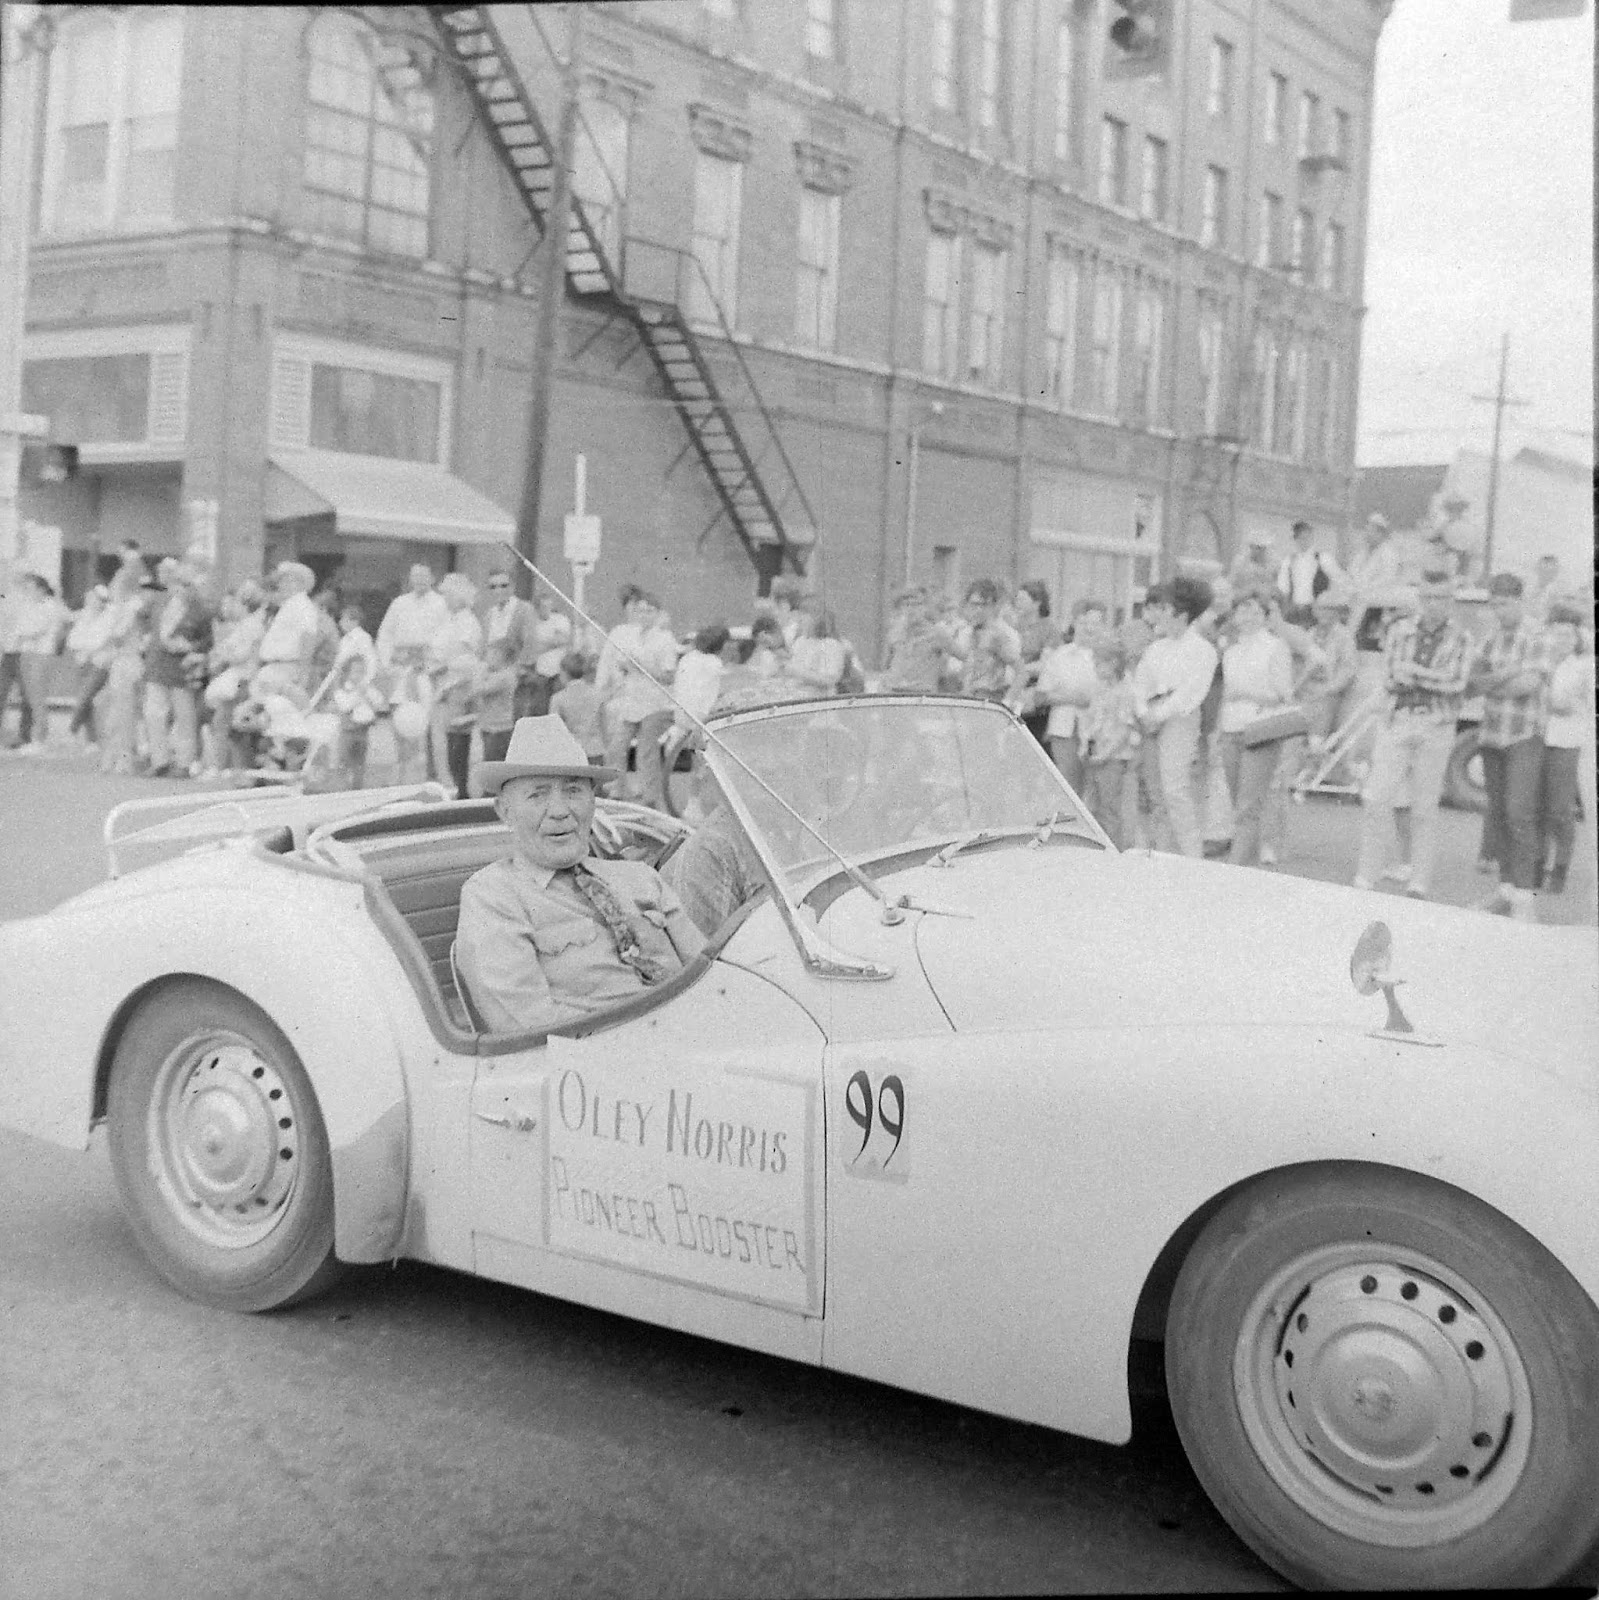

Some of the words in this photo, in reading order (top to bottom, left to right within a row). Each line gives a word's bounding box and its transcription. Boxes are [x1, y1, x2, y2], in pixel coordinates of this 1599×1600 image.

[560, 1069, 653, 1146] OLEY
[667, 1089, 788, 1173] NORRIS
[846, 1070, 905, 1169] 99
[552, 1156, 666, 1244] PIONEER
[668, 1183, 806, 1274] BOOSTER
